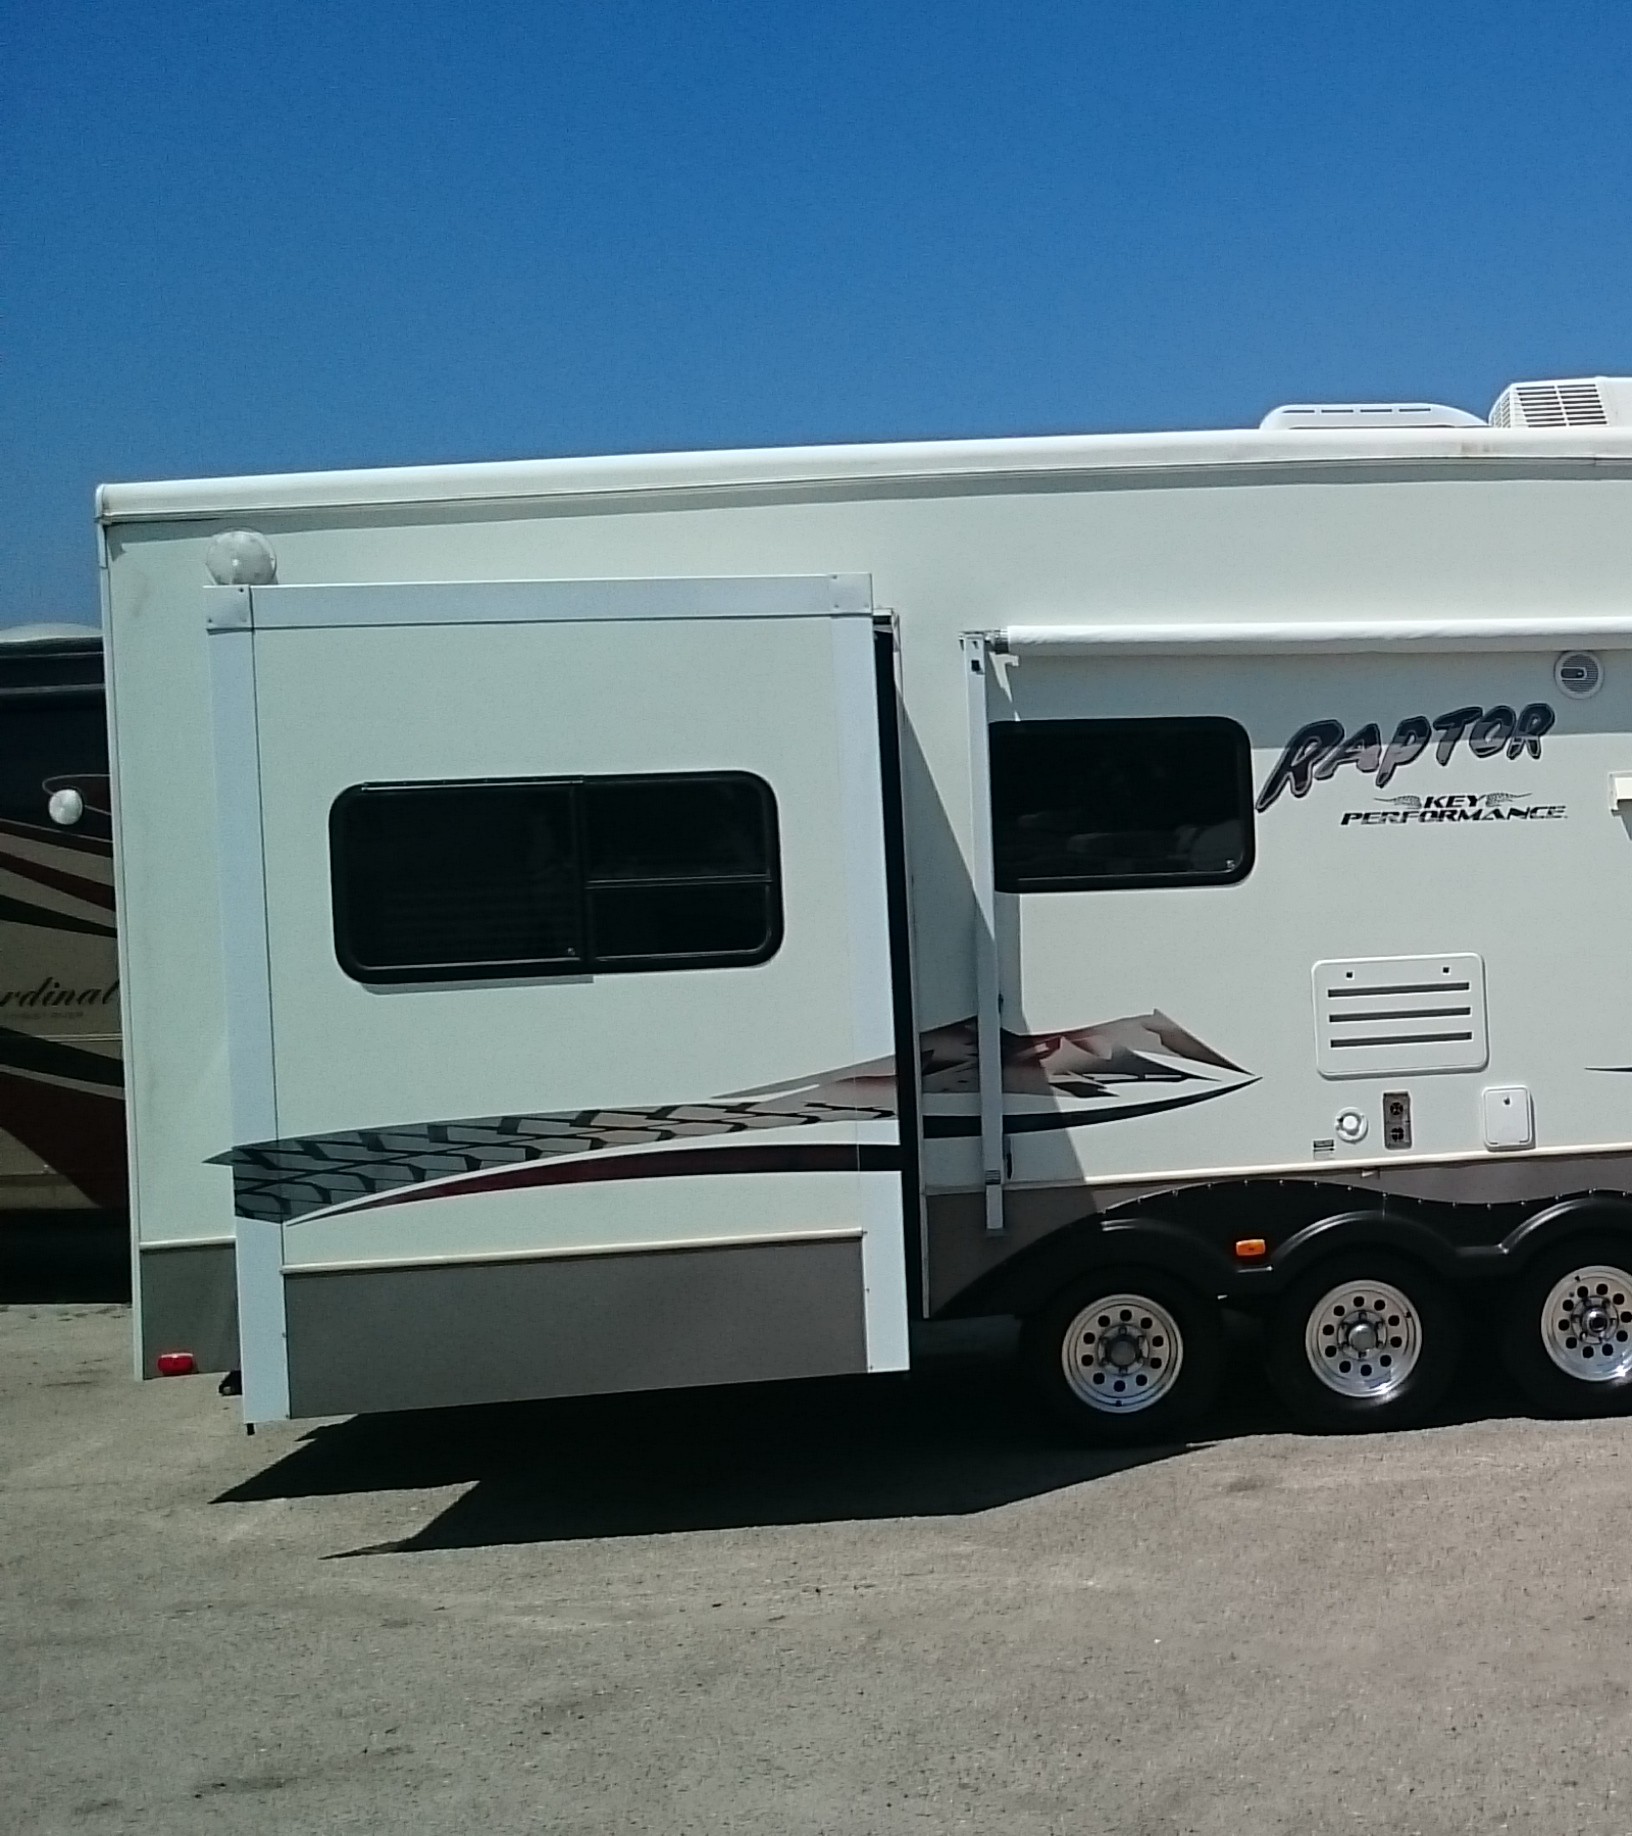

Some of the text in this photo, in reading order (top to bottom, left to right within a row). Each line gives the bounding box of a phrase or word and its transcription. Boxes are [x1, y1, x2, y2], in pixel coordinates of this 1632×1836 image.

[1256, 703, 1555, 812] RAPTOR
[1424, 794, 1487, 809] KEY
[1340, 806, 1567, 826] PERFORMANCE
